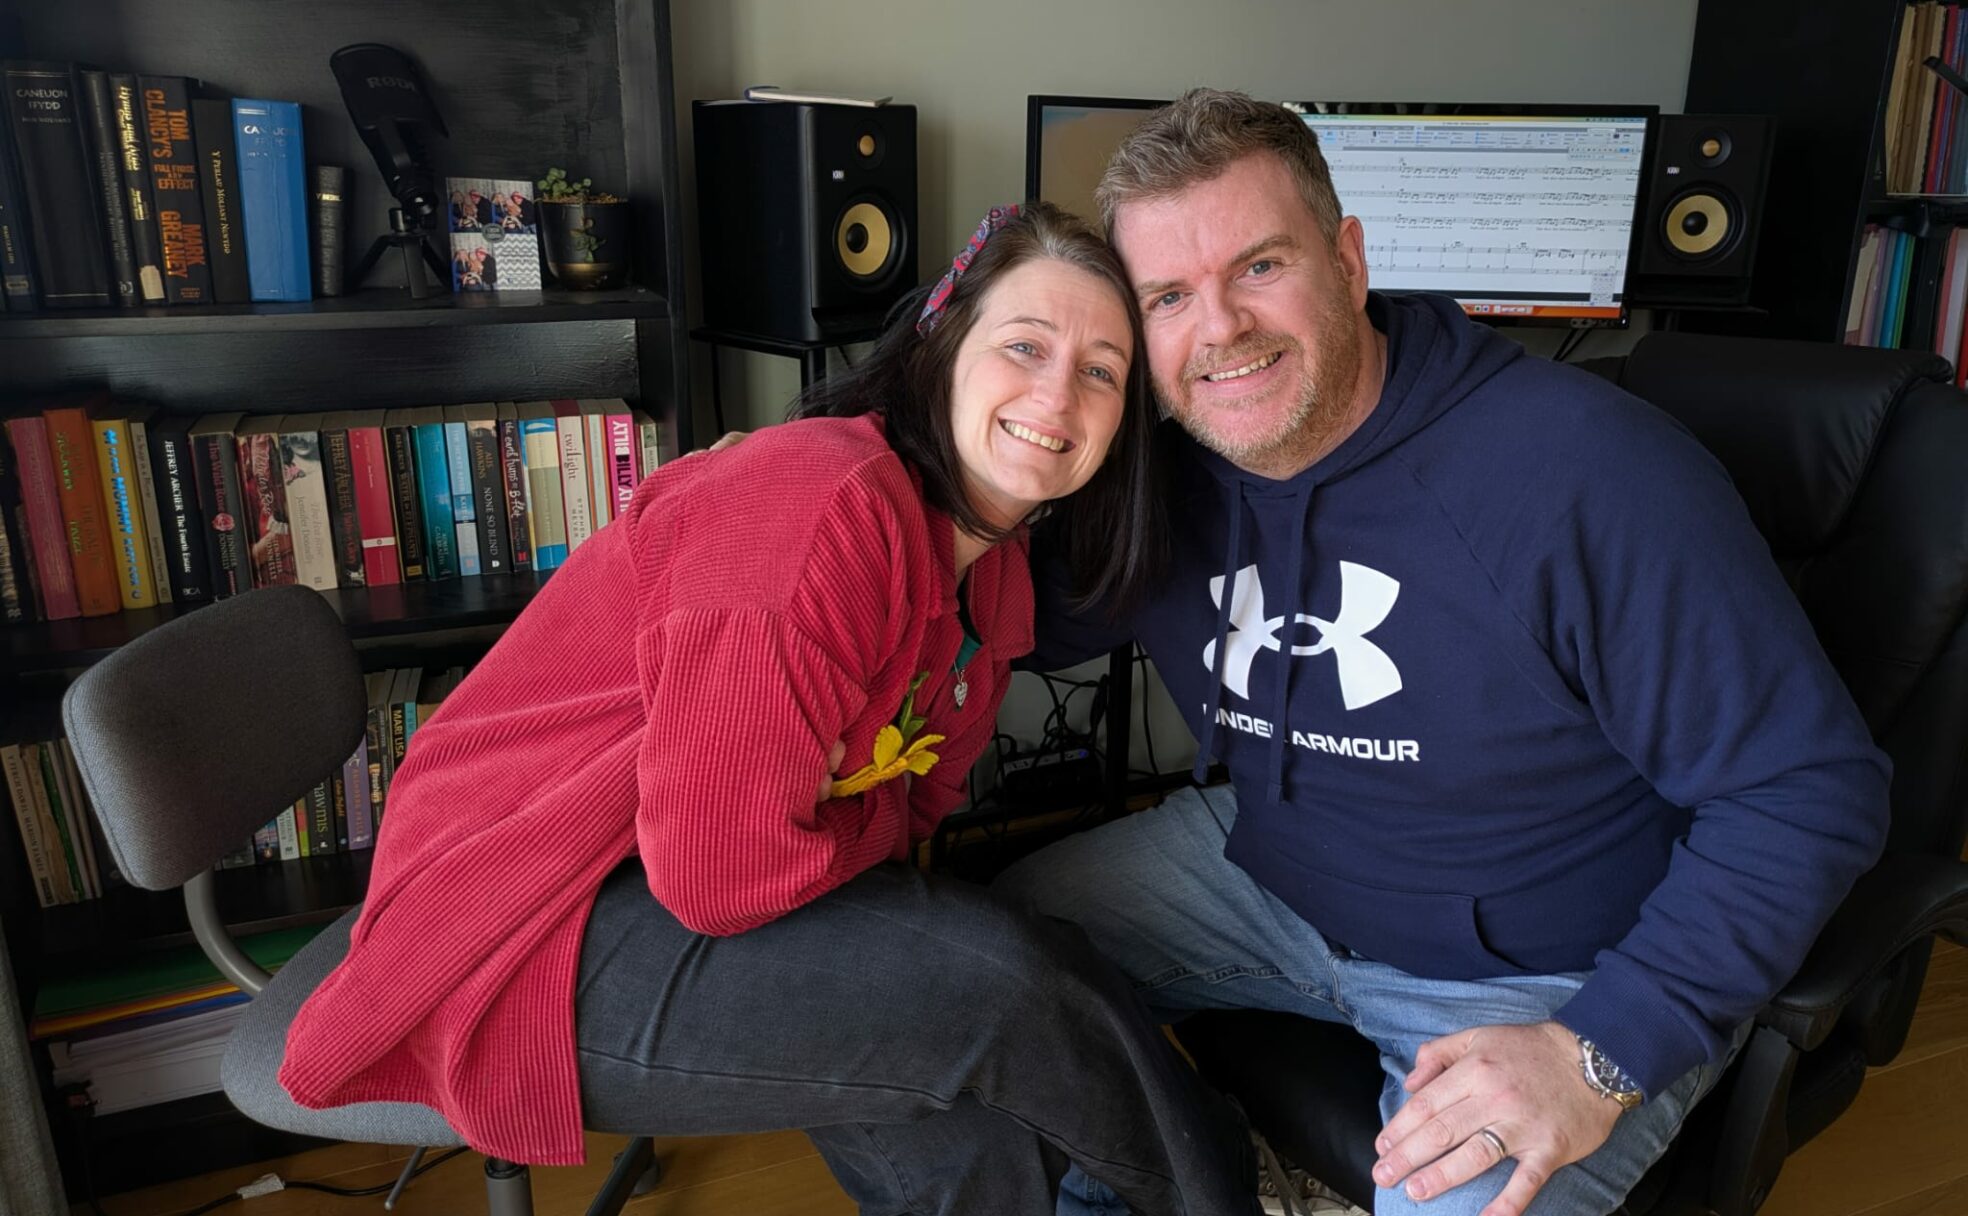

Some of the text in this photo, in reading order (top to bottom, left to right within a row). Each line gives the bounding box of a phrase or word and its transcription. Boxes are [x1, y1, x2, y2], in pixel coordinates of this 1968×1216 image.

[16, 88, 69, 99] CANEUON
[145, 89, 172, 158] CLANCY'S
[167, 109, 190, 141] TOM
[216, 189, 227, 222] MOLIANT
[160, 210, 188, 278] GREANEY
[182, 223, 206, 265] MARK
[504, 421, 514, 434] the
[504, 436, 519, 458] earth
[612, 421, 630, 455] BILLY
[327, 434, 348, 471] JEFFREY
[475, 441, 487, 479] HAWKINS
[505, 458, 520, 482] hums
[563, 434, 582, 480] twilight
[616, 454, 632, 488] BILLY
[103, 429, 119, 445] M
[111, 477, 133, 534] MUMMY
[208, 441, 227, 512] The Wild Rose
[164, 440, 193, 573] JEFFREY ARCHER The Fourth Estate
[483, 487, 500, 556] NONE SO BLIND
[576, 498, 586, 540] STEPHEN
[392, 709, 405, 758] MARI LISA
[1202, 703, 1420, 762] NDE ARMOUR
[16, 788, 28, 813] DAWEL
